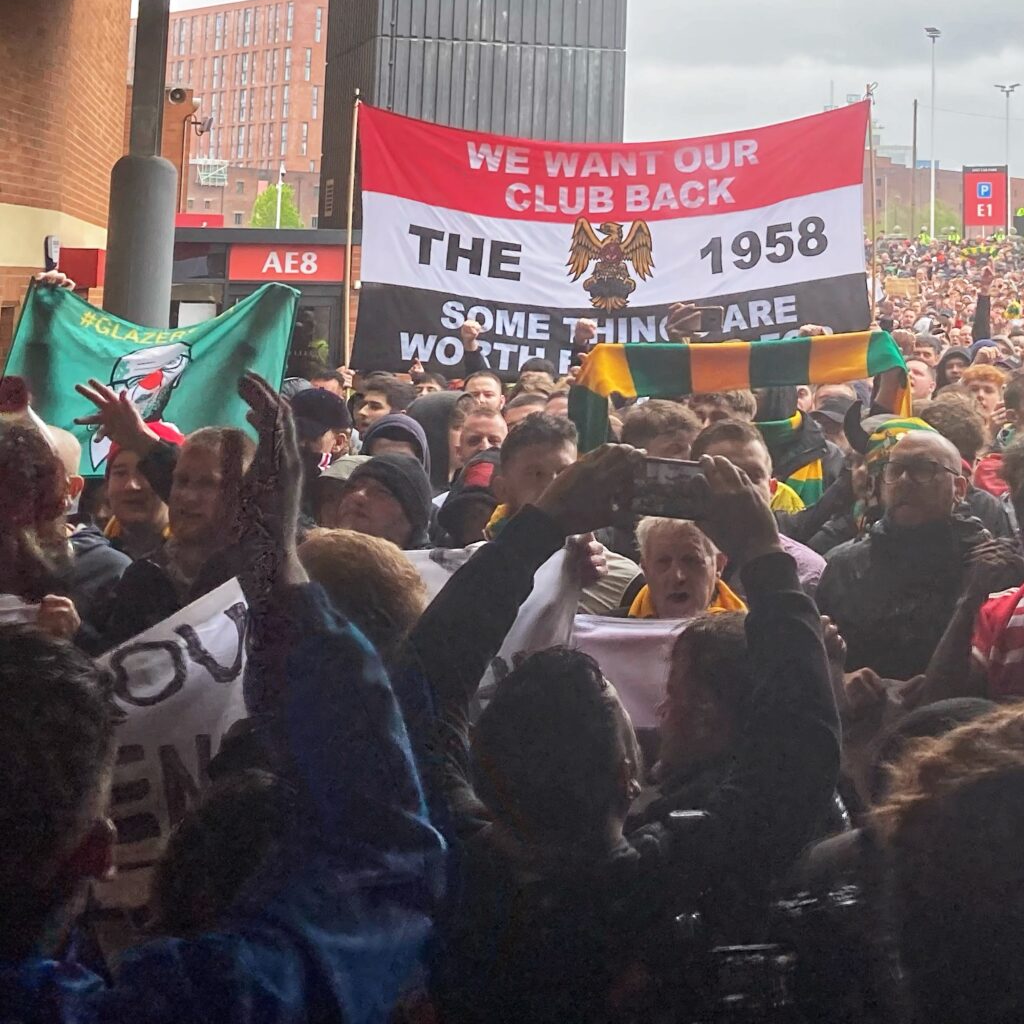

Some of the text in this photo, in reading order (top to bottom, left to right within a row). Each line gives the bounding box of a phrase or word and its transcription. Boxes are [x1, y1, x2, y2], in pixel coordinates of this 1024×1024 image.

[467, 139, 760, 178] WE WANT OUR
[505, 177, 736, 215] CLUB BACK
[977, 203, 993, 217] E1
[261, 251, 318, 275] AE8
[408, 216, 828, 281] THE 1958
[441, 301, 551, 341] SOME
[722, 295, 798, 333] ARE
